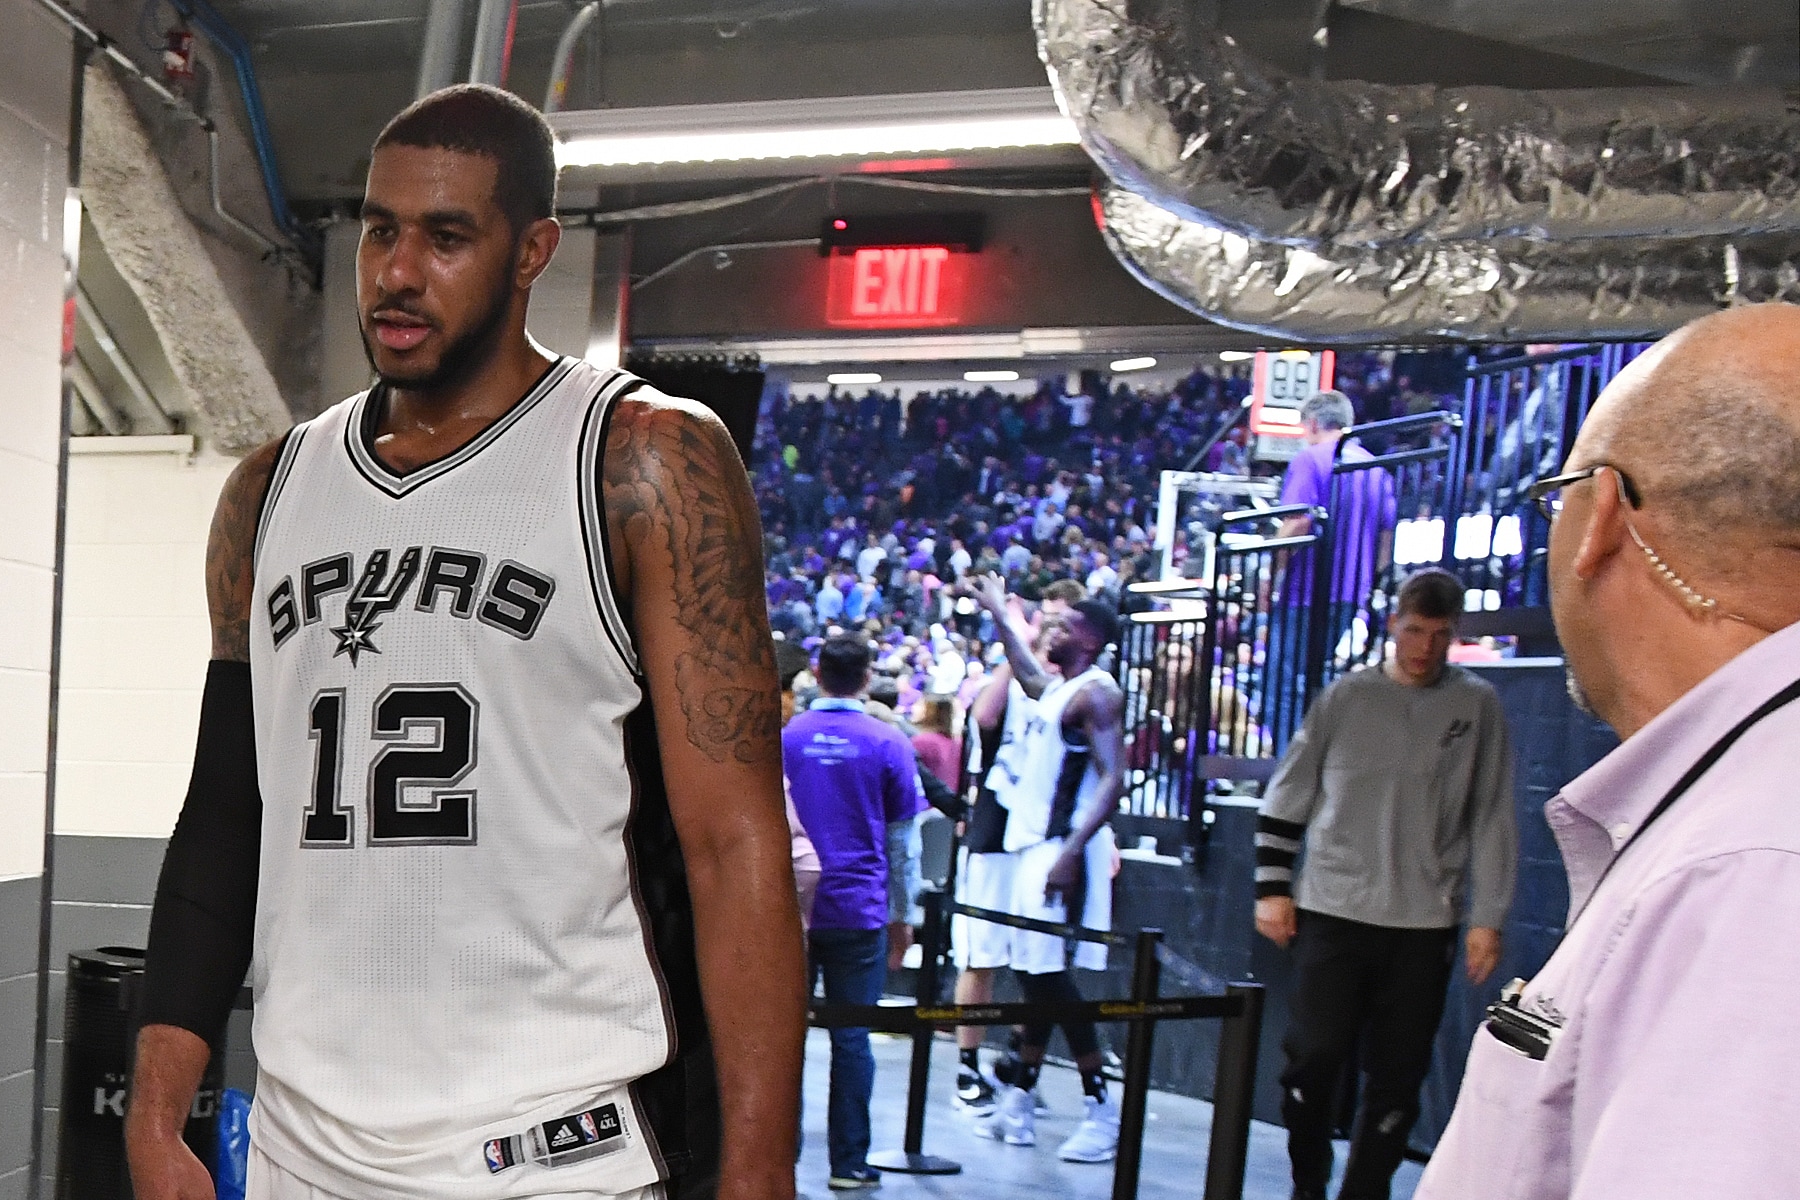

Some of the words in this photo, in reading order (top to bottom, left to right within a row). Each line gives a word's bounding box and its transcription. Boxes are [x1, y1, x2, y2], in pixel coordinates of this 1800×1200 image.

[851, 247, 949, 317] EXIT
[267, 546, 557, 669] SPURS
[299, 682, 480, 849] 12
